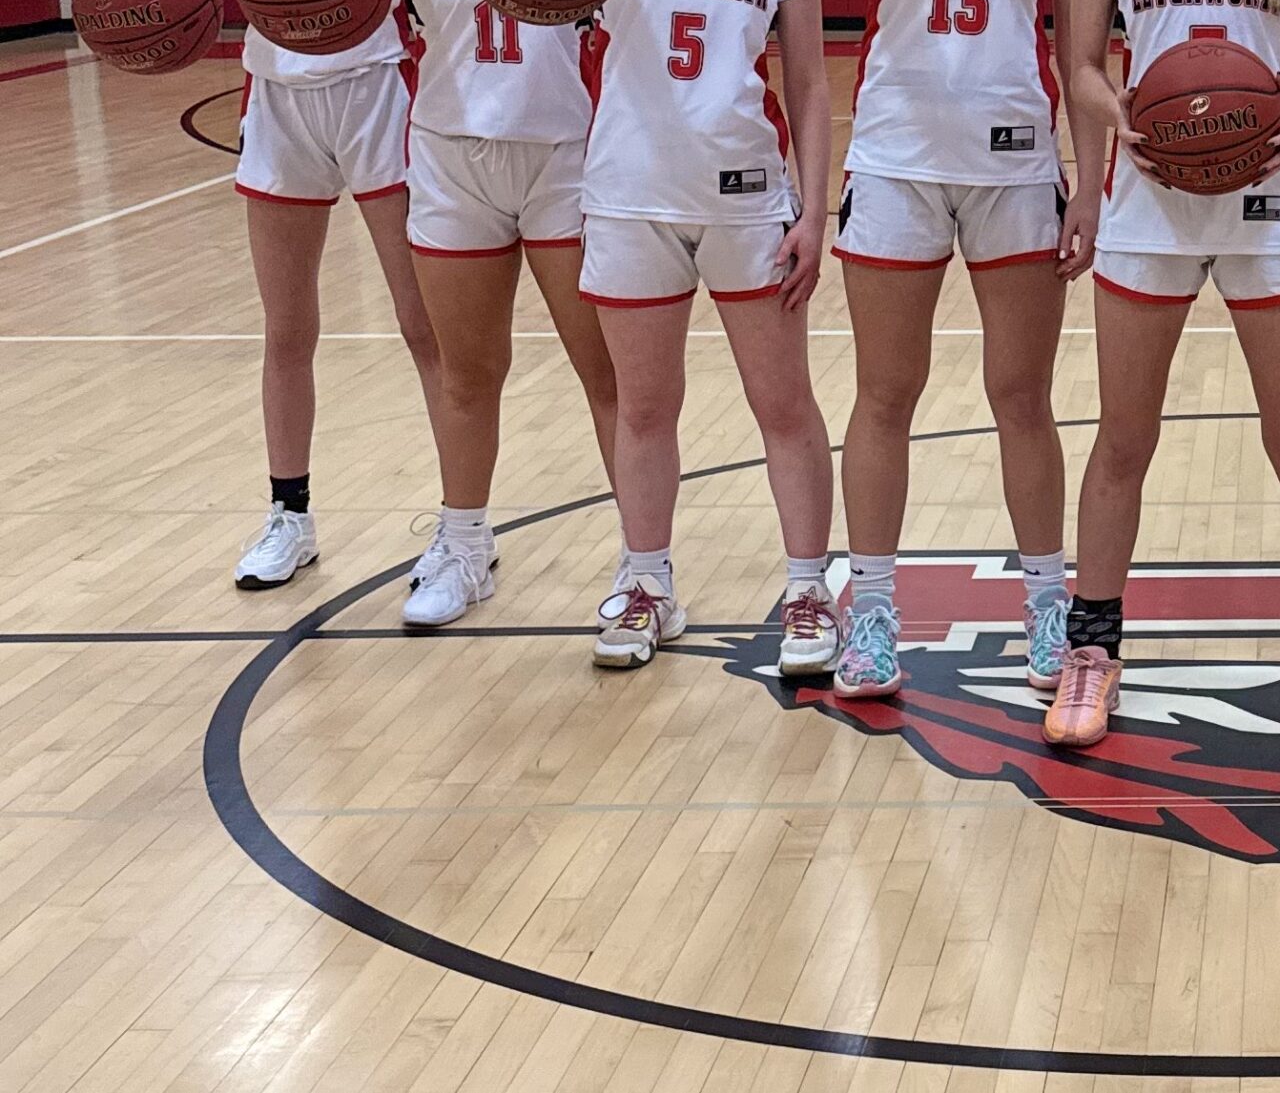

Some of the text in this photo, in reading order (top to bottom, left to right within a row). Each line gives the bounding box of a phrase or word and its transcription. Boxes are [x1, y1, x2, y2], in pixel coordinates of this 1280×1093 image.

[473, 0, 523, 64] 11
[667, 11, 707, 81] 5
[1152, 104, 1260, 147] SPALDING
